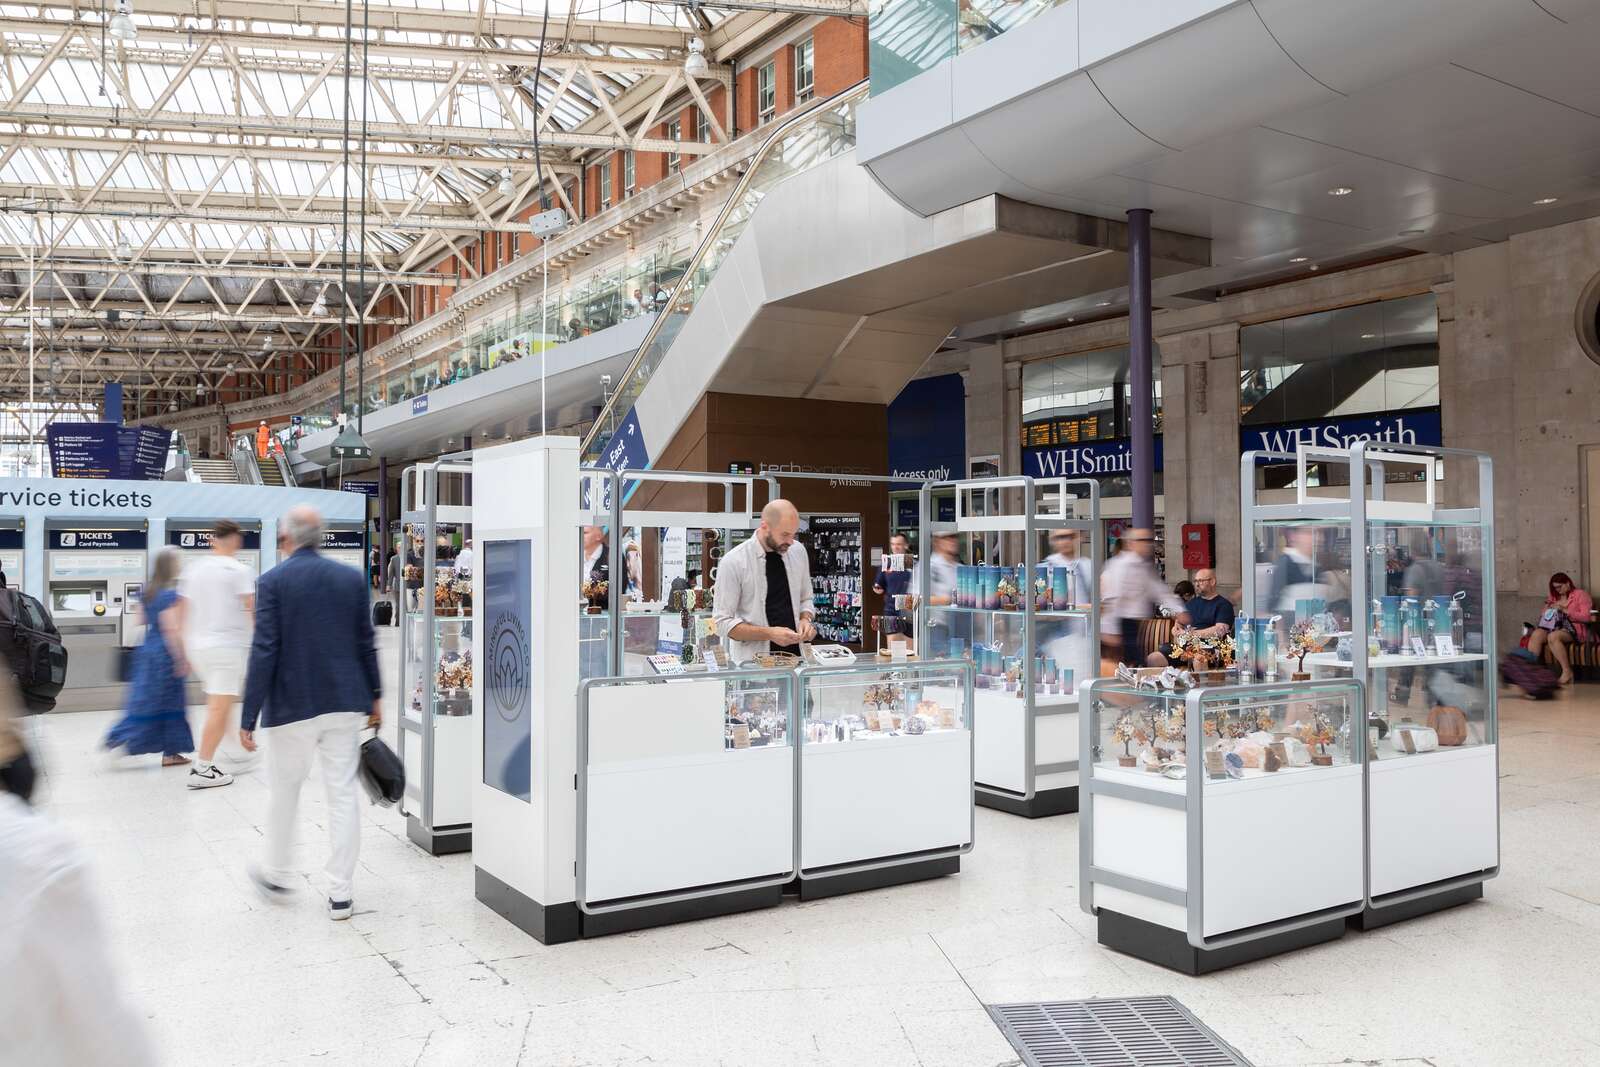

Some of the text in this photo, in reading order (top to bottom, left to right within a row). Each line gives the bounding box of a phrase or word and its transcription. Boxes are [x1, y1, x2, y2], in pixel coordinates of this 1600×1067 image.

[1259, 418, 1417, 461] WHSmith
[609, 440, 625, 465] East
[1035, 446, 1132, 477] WHSmit
[892, 465, 950, 481] Access only
[69, 488, 152, 508] tickets
[78, 532, 113, 540] TICKETS
